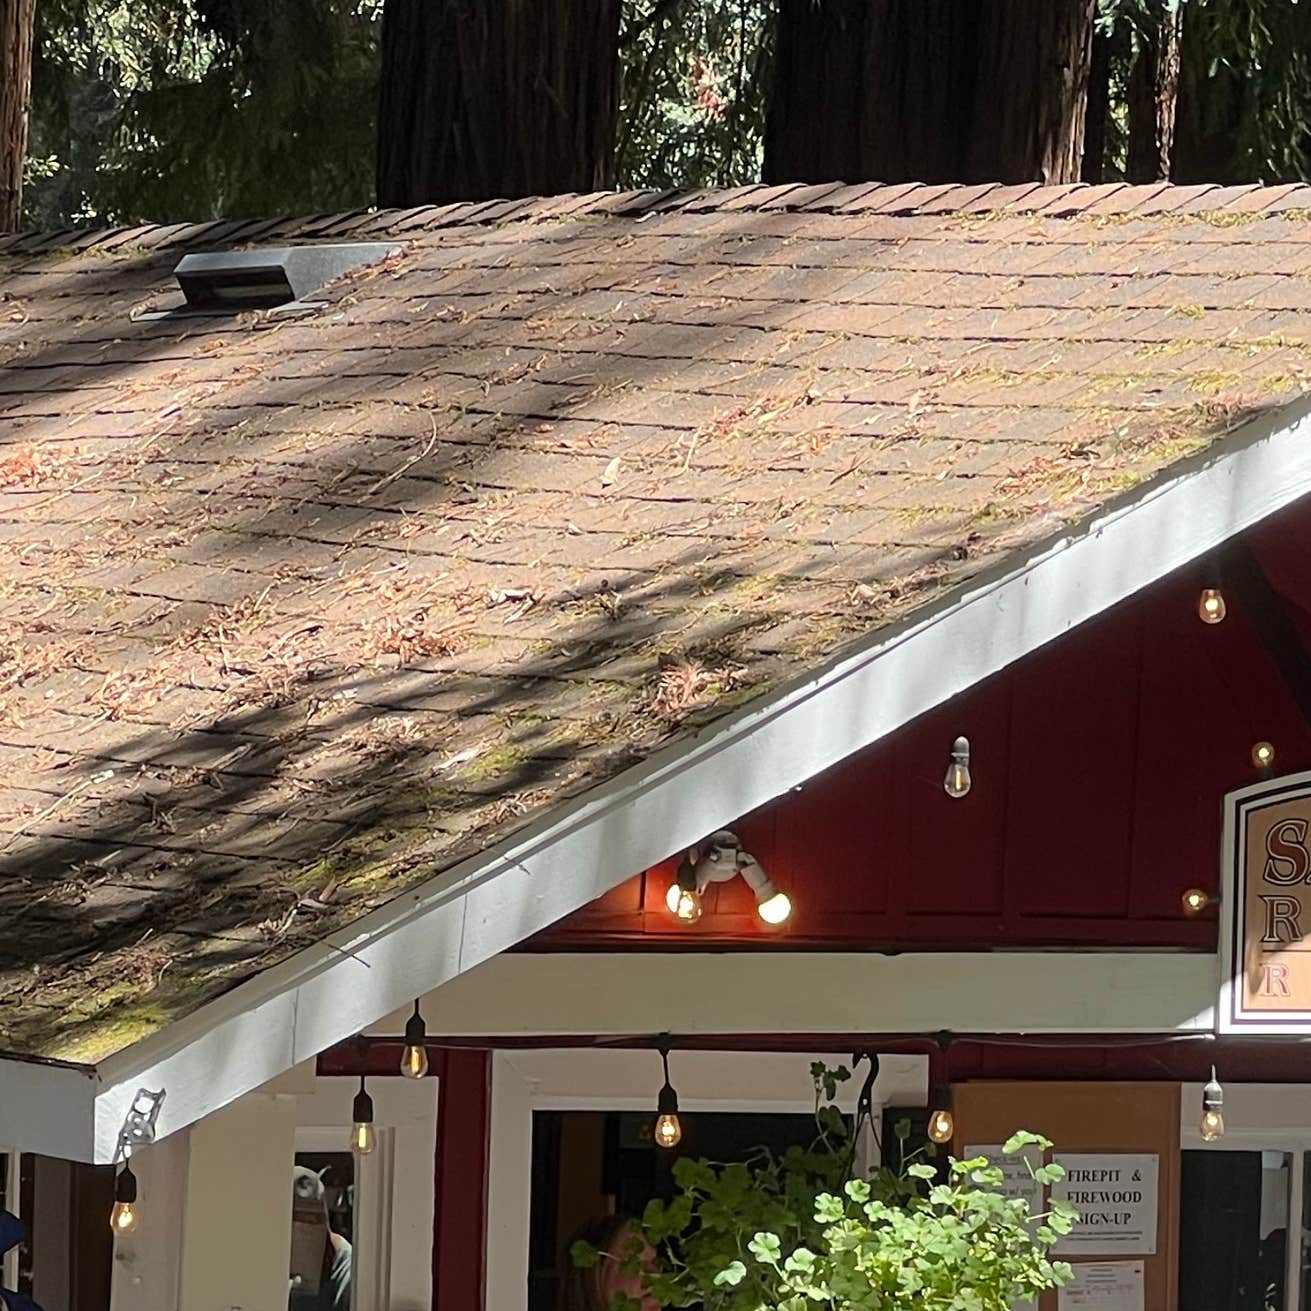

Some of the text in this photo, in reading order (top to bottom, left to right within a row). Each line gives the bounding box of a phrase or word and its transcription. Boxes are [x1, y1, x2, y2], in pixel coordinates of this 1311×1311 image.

[1067, 1169, 1143, 1183] FIREPIT &
[1067, 1191, 1143, 1204] FIREWOOD
[1074, 1212, 1132, 1226] SIGN-UP
